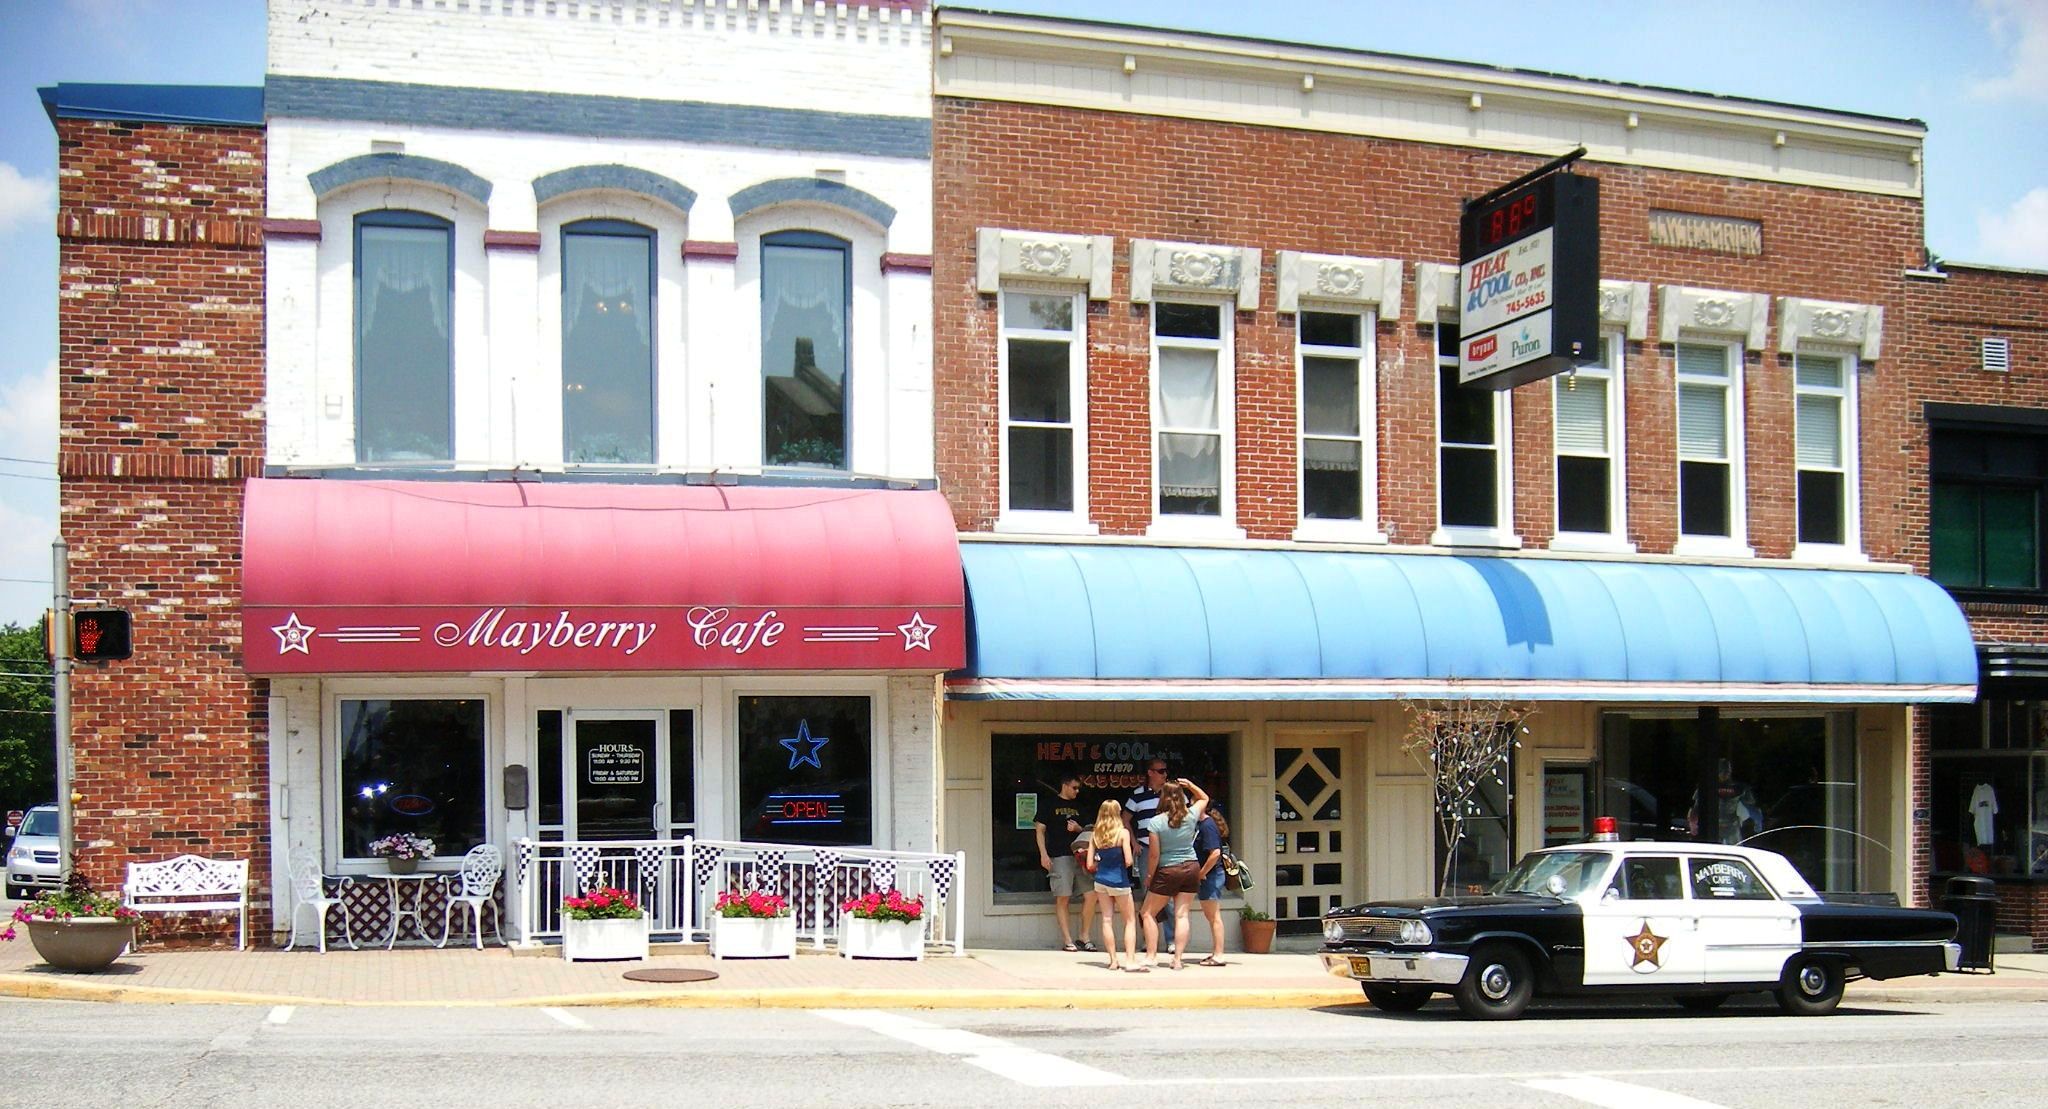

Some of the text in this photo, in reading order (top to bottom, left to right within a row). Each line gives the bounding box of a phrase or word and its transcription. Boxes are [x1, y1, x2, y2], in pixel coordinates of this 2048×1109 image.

[1468, 250, 1510, 291] HEAT
[1478, 270, 1513, 308] COOL
[1506, 291, 1545, 315] 745-5635
[1512, 339, 1541, 358] Puron
[434, 606, 785, 655] Mayberry Cafe
[599, 744, 634, 752] HOURS
[1036, 742, 1086, 761] HEAT
[1104, 742, 1150, 761] COOL
[783, 801, 828, 818] OPEN
[1695, 863, 1748, 884] MAYBERRY
[1712, 875, 1731, 884] CAFE
